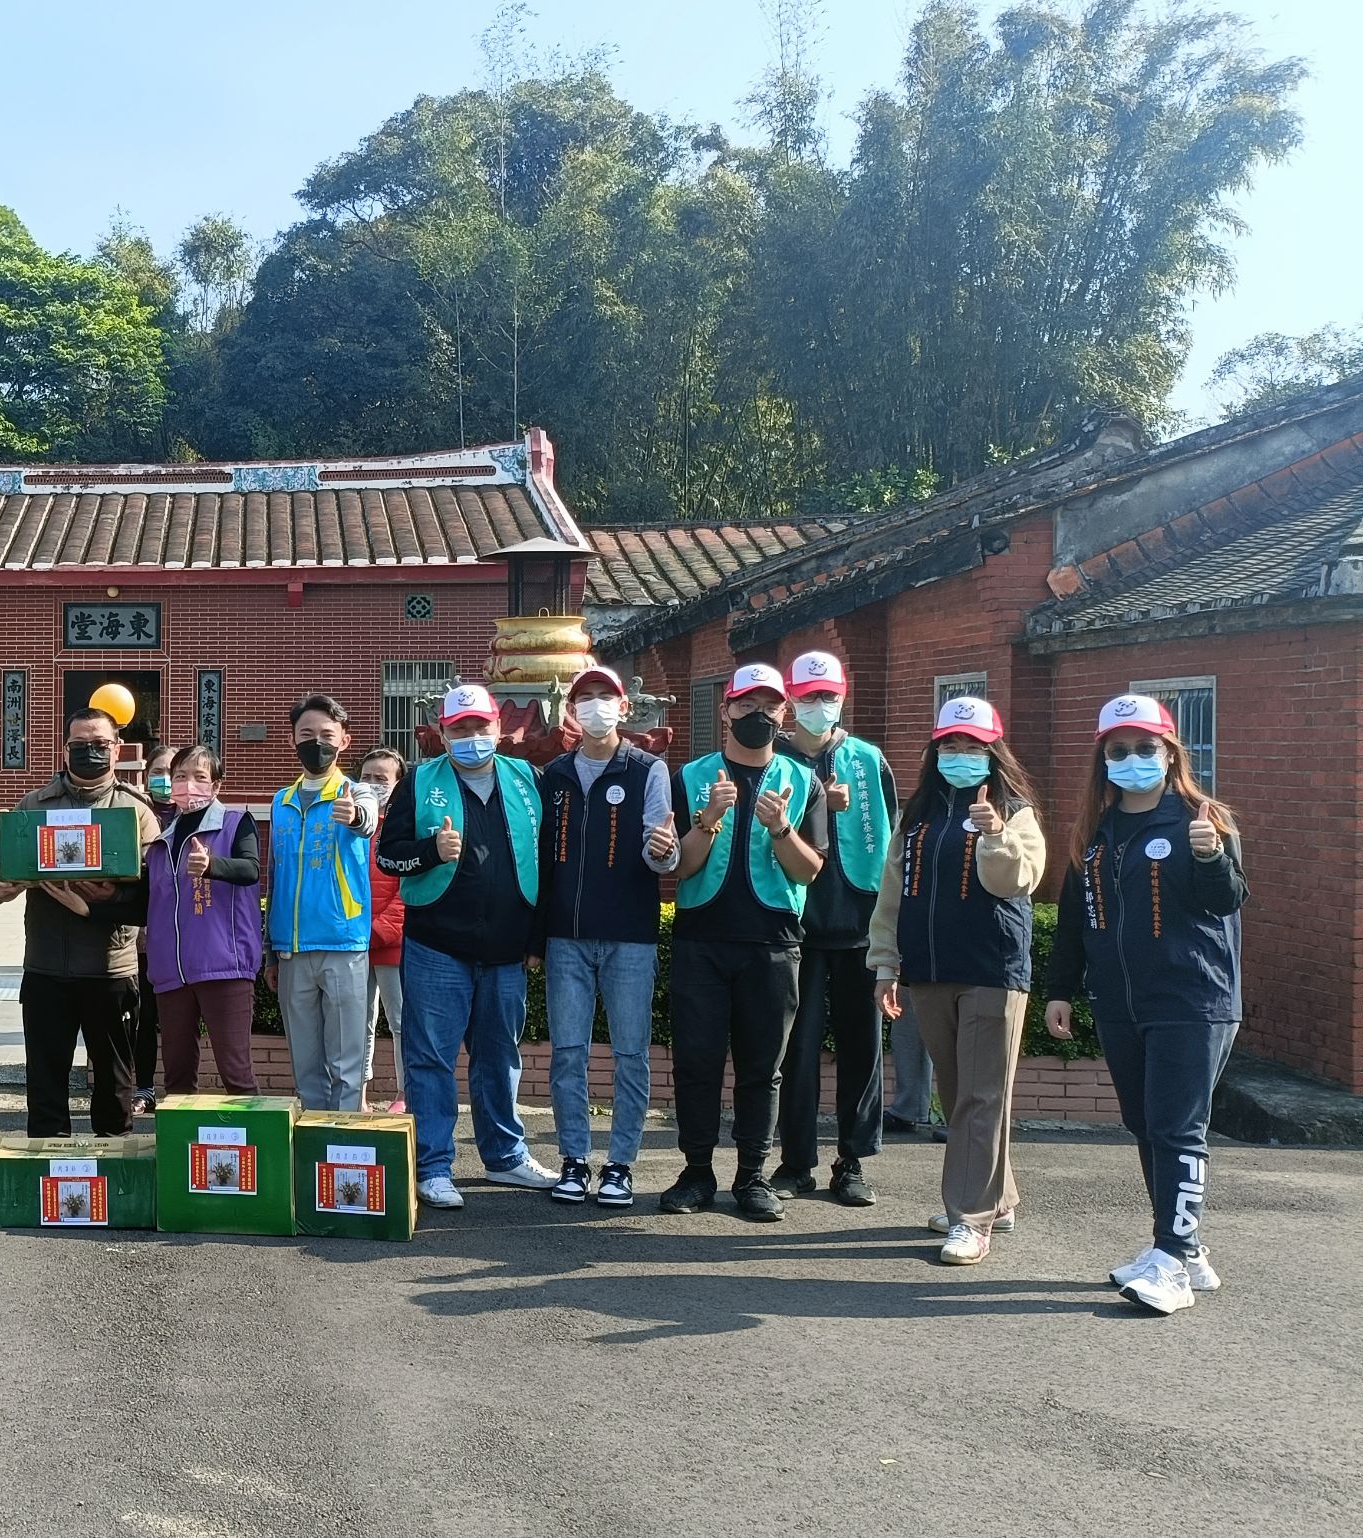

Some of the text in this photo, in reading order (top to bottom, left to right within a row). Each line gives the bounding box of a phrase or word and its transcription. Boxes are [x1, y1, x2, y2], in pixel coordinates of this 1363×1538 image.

[70, 611, 153, 640] 東海堂
[7, 679, 22, 760] 南洲世澤長
[203, 679, 217, 752] 東海家聲
[851, 759, 875, 853] 隆祥經濟發展基金會
[1173, 1154, 1205, 1236] FILA
